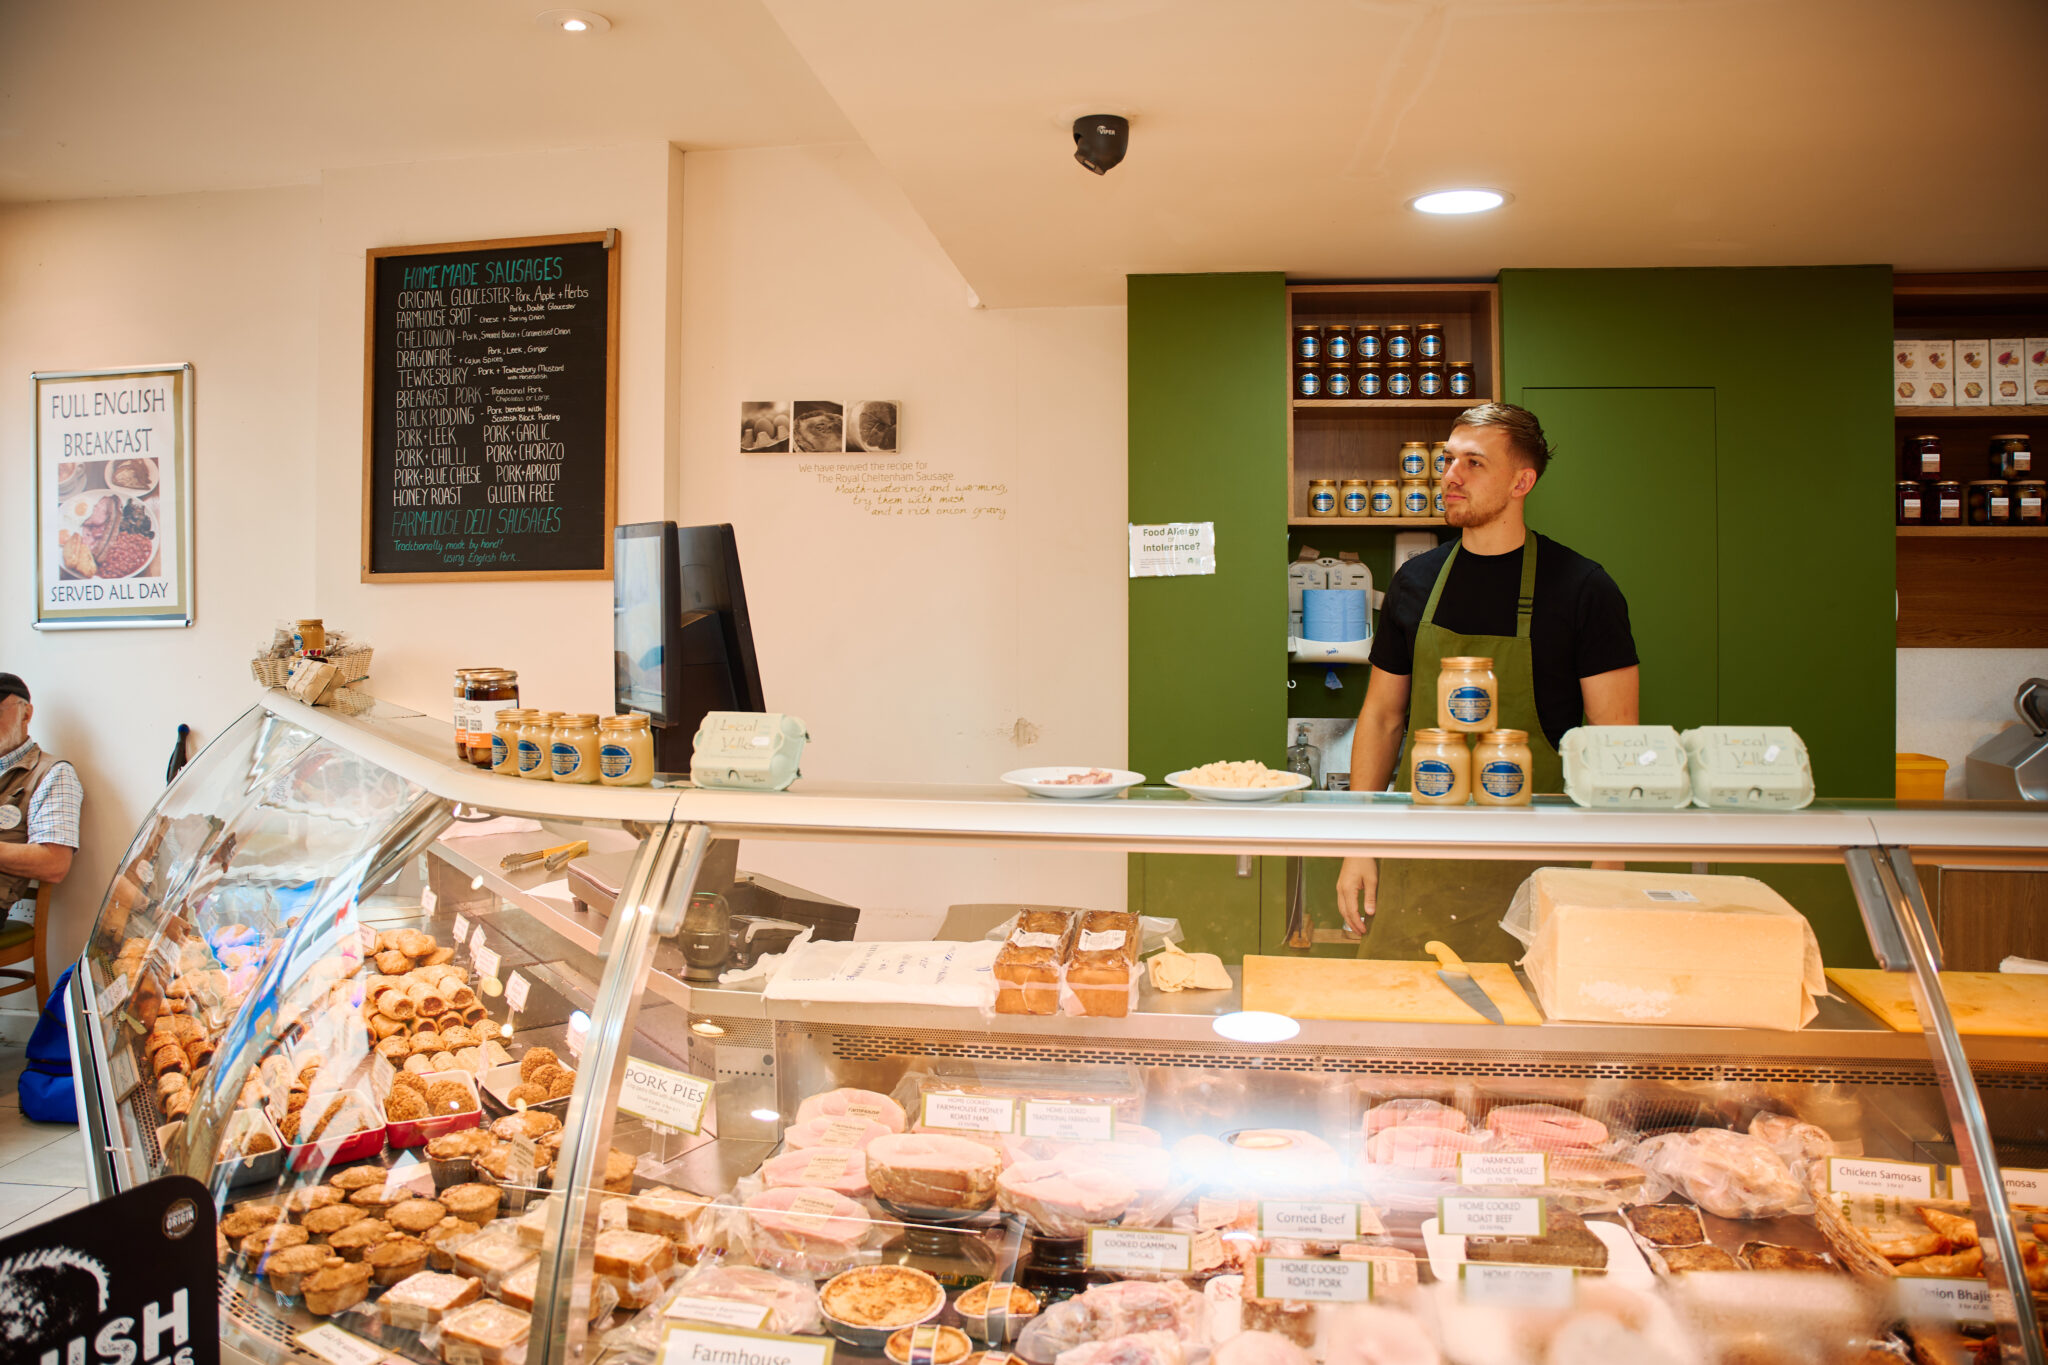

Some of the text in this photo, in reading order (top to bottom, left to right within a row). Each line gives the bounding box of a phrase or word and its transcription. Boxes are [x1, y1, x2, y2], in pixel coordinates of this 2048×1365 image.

[404, 257, 563, 289] HOMEMADE SAUSAGES
[398, 290, 447, 310] ORIGINAL
[451, 287, 510, 307] GLOUCESTER
[535, 285, 555, 302] Apple
[564, 283, 589, 299] Herbs
[526, 303, 545, 312] Double
[547, 302, 576, 311] Gloucester
[396, 309, 446, 329] FARMHOUSE
[450, 306, 472, 326] SPOT
[479, 316, 499, 324] Cheese
[508, 314, 527, 323] Spring
[501, 329, 516, 339] Bacon
[553, 327, 571, 336] Onion
[527, 345, 548, 354] Ginger
[396, 348, 452, 368] DRAGONFIRE
[464, 356, 504, 366] Cajun Spices
[397, 367, 469, 388] TEWKESBURY
[478, 366, 494, 376] Pork
[537, 364, 565, 372] Mustard
[52, 388, 165, 419] FULL ENGLISH
[396, 385, 543, 409] BREAKFAST PORK Traditional Pork
[534, 394, 550, 402] Large
[396, 408, 428, 428] BLACK
[429, 406, 475, 426] PUDDING
[486, 405, 503, 415] Pork
[505, 405, 526, 413] blended
[491, 412, 561, 423] Scottish Black Pudding
[397, 427, 457, 448] PORK LEEK
[483, 423, 550, 443] PORK GARLIC
[63, 428, 153, 457] BREAKFAST
[395, 447, 466, 467] PORK CHILLI
[486, 443, 565, 463] PORK CHORIZO
[450, 466, 482, 484] CHEESE
[799, 461, 928, 473] We have revived the recipe for
[817, 471, 954, 484] The Royal Cheltenham Sausage
[393, 487, 463, 506] HONEY ROAST
[487, 484, 555, 504] GLUTEN FREE
[835, 482, 924, 495] Mouth-watering
[929, 482, 950, 492] and
[853, 493, 965, 511] try them with mash
[871, 505, 892, 515] and
[908, 504, 930, 515] rich
[936, 507, 966, 515] onion
[972, 506, 1006, 520] gravy
[392, 506, 563, 536] FARMHOUSE DELI SAUSAGES
[1143, 528, 1165, 537] Food
[394, 539, 443, 554] Traditionally
[445, 540, 465, 549] made
[469, 538, 479, 552] by
[1143, 542, 1201, 552] Intolerance?
[443, 553, 465, 566] using
[468, 552, 497, 566] English
[51, 582, 169, 602] SERVED ALL DAY
[625, 1068, 705, 1103] PORK PIES
[936, 1103, 977, 1113] FARMHOUSE
[950, 1113, 971, 1121] ROAST
[1839, 1166, 1922, 1183] Chicken Samosas
[2006, 1179, 2037, 1189] mosas
[1459, 1202, 1521, 1211] HOME COOKED
[166, 1210, 194, 1230] ORIGIN
[1276, 1212, 1346, 1224] Corned Beef
[1467, 1214, 1513, 1223] ROAST BEEF
[1104, 1240, 1177, 1250] COOKED GAMMON
[1281, 1263, 1349, 1275] HOME COOKED
[1288, 1277, 1342, 1288] ROAST PORK
[692, 1343, 791, 1365] Farmhouse
